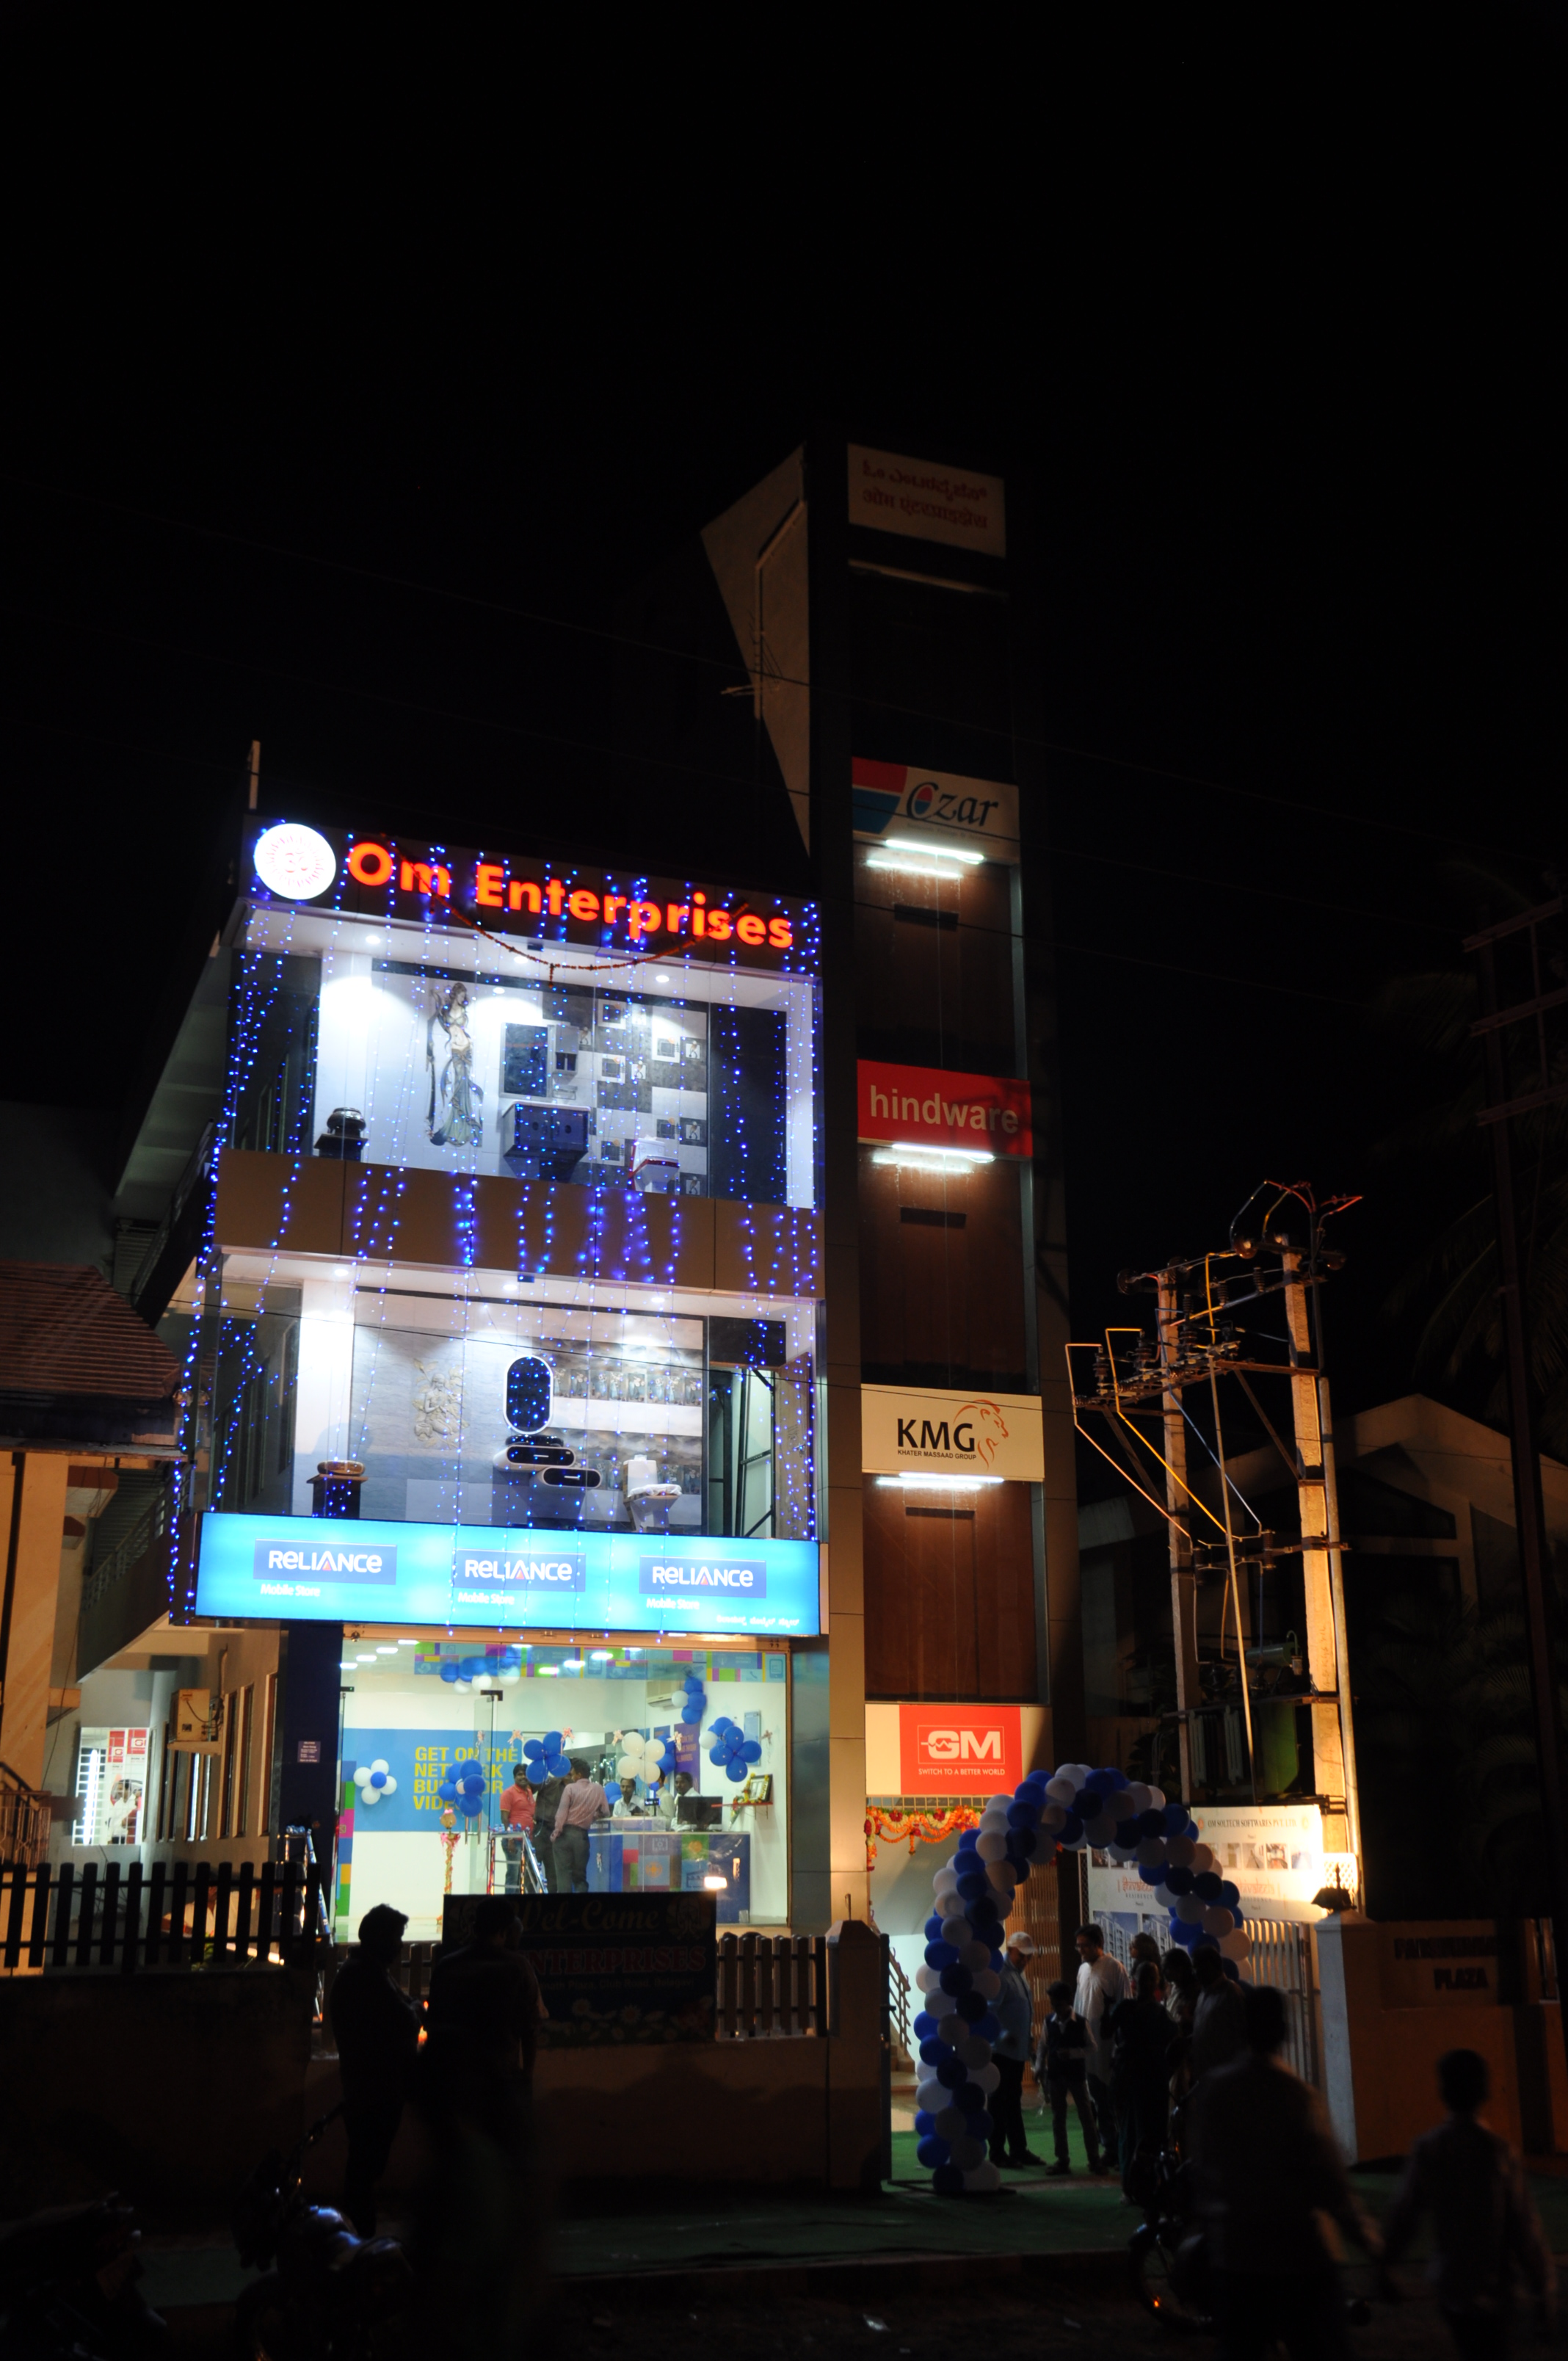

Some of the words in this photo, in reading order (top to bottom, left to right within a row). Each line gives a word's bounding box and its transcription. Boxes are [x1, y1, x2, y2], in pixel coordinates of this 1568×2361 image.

[907, 782, 998, 827] Czar
[347, 842, 451, 897] Om
[476, 864, 793, 949] Enterprises
[870, 1084, 1019, 1134] hindware
[897, 1418, 975, 1452] KMG
[923, 1451, 954, 1459] MASSAAD
[260, 1584, 294, 1595] Mobile
[295, 1585, 321, 1597] Store
[457, 1592, 490, 1603] Mobile
[490, 1593, 515, 1606] Store
[647, 1597, 676, 1609] Mobile
[677, 1599, 700, 1609] Store
[928, 1730, 1001, 1759] GM
[415, 1747, 449, 1761] GET
[454, 1747, 479, 1761] ON
[485, 1748, 518, 1762] THE
[414, 1763, 504, 1778] NETRK
[413, 1796, 460, 1810] VIDE
[1208, 1819, 1216, 1827] OM
[518, 1946, 706, 1975] NTERPRISES
[1434, 1967, 1489, 1990] PLAZA
